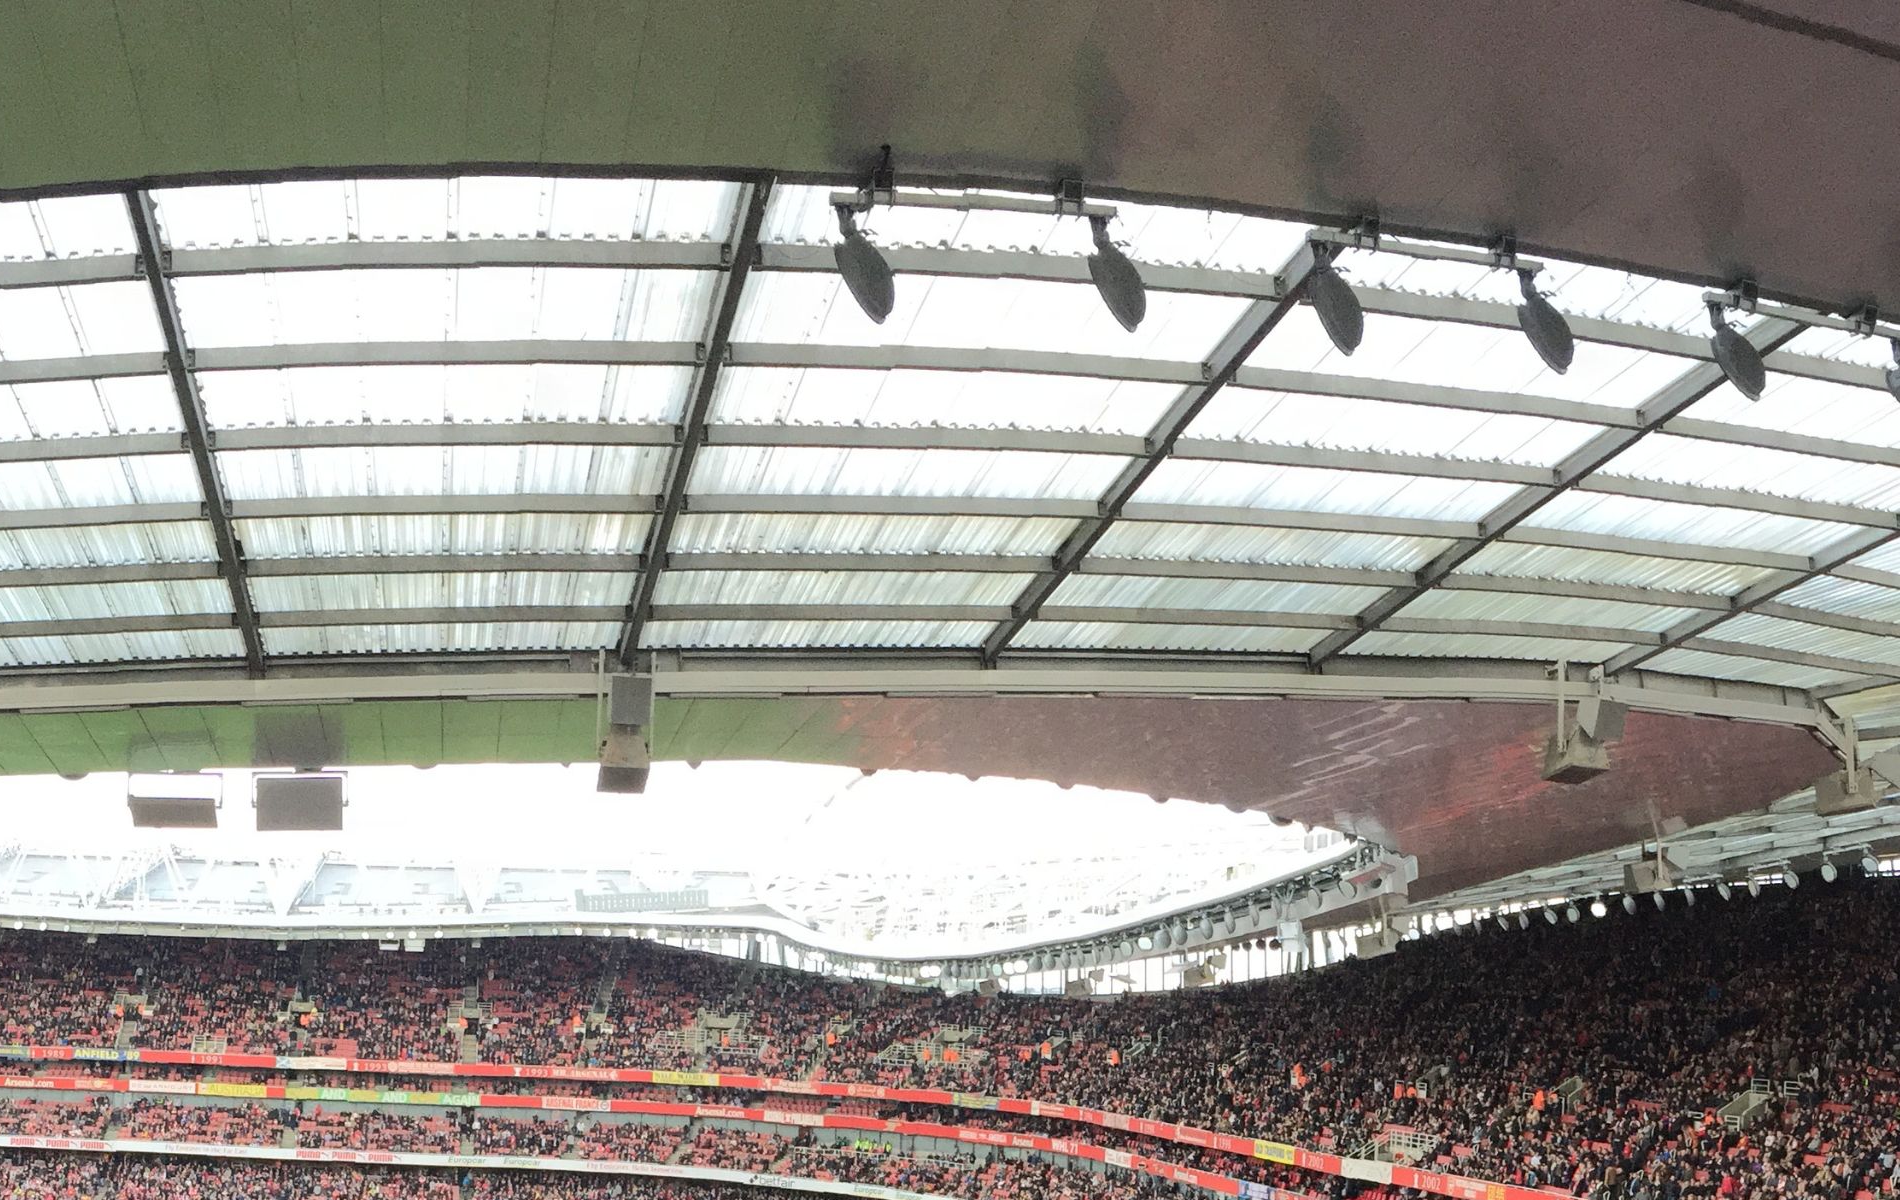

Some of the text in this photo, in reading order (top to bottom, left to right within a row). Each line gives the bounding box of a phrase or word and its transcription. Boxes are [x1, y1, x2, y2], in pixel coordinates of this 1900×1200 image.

[42, 1050, 65, 1058] 1989
[74, 1050, 119, 1060] ANFIELD
[200, 1055, 223, 1064] 1991
[525, 1068, 549, 1077] 1993
[4, 1077, 55, 1088] Arsenal.com
[321, 1089, 347, 1100] AND
[382, 1092, 406, 1103] AND
[442, 1094, 480, 1106] AGAIN
[695, 1106, 745, 1119] Arsenal.com
[10, 1137, 105, 1150] PUMA PUMA PUMA
[296, 1150, 393, 1163] PUMA PUMA PUMA
[448, 1156, 486, 1166] Europcar
[503, 1157, 541, 1168] Europcar
[759, 1175, 795, 1188] betfair
[1422, 1175, 1441, 1190] 2002
